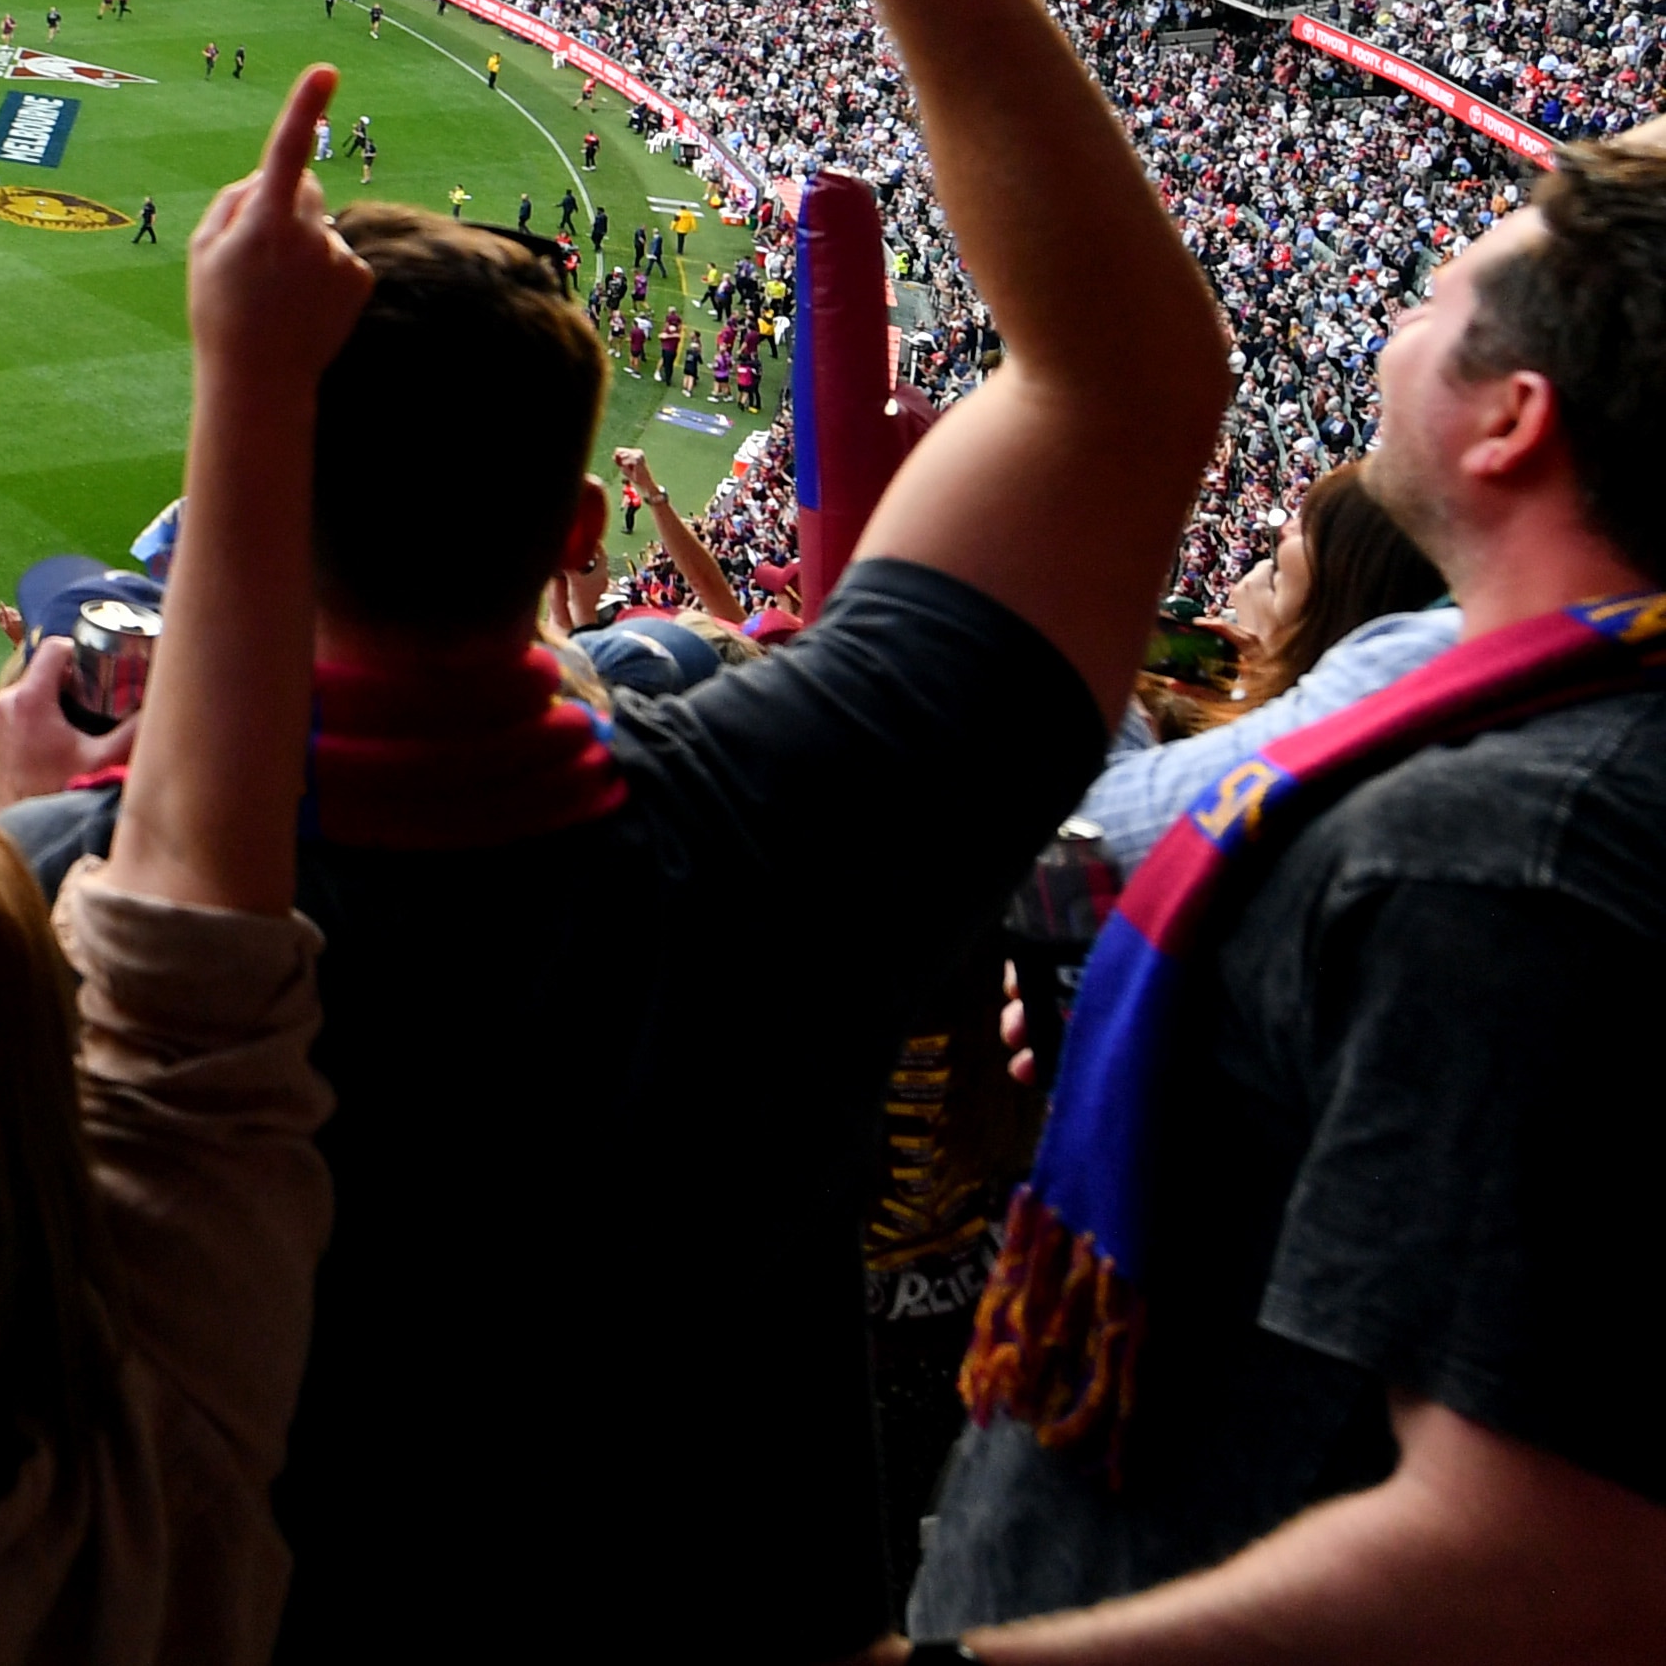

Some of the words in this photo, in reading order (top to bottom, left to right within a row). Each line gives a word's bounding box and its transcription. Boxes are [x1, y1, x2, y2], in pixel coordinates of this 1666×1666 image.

[1316, 28, 1348, 53] TOYOTA
[0, 95, 64, 164] MELBOURNE
[1482, 113, 1516, 144] TOYOTA
